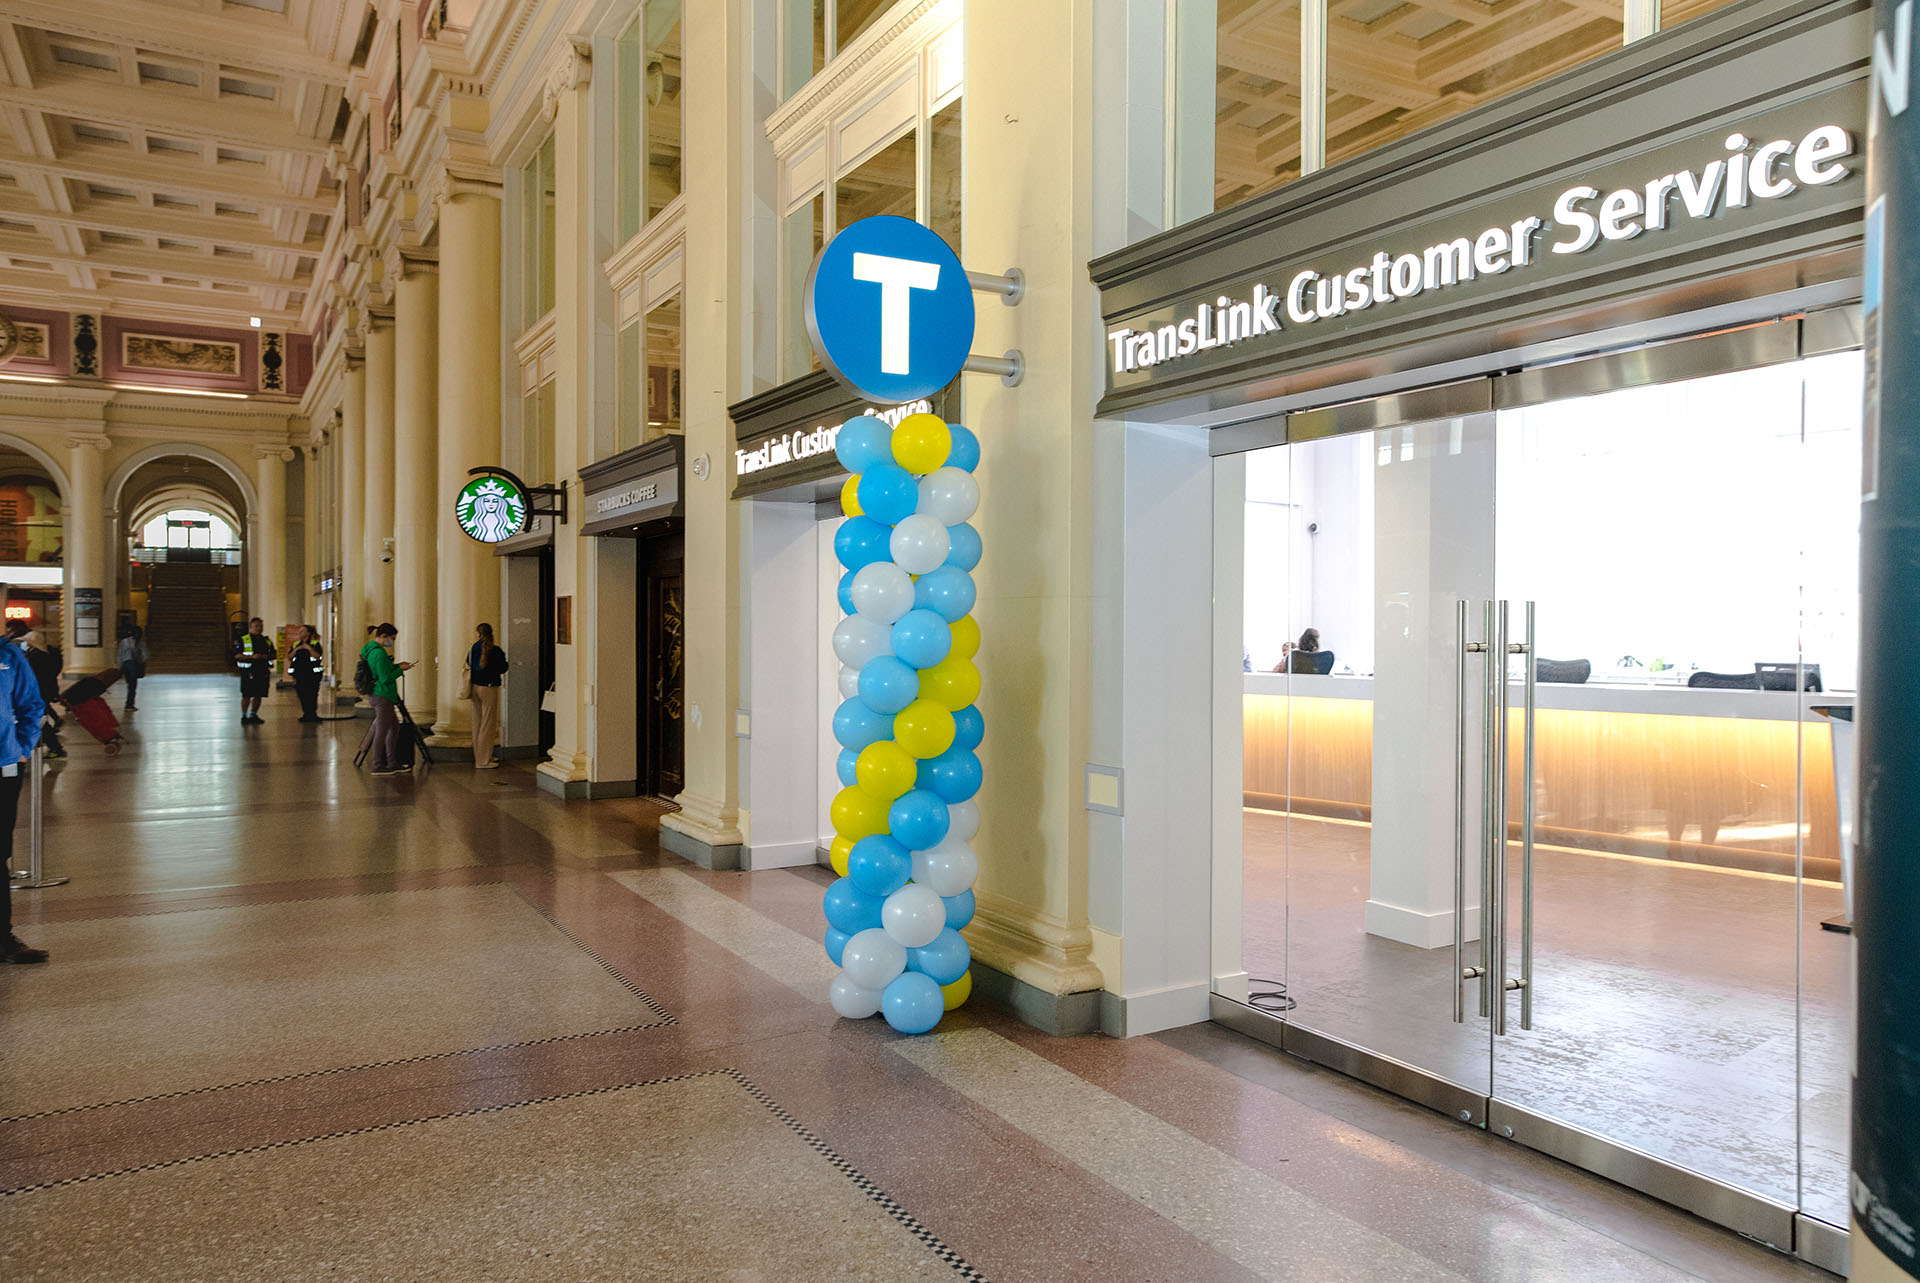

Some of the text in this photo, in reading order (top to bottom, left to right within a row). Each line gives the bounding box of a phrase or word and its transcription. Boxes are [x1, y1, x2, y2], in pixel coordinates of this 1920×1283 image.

[1108, 125, 1853, 373] TransLink Customer Service
[853, 252, 941, 375] T
[631, 484, 657, 504] COFFEE
[735, 434, 792, 475] TransLink
